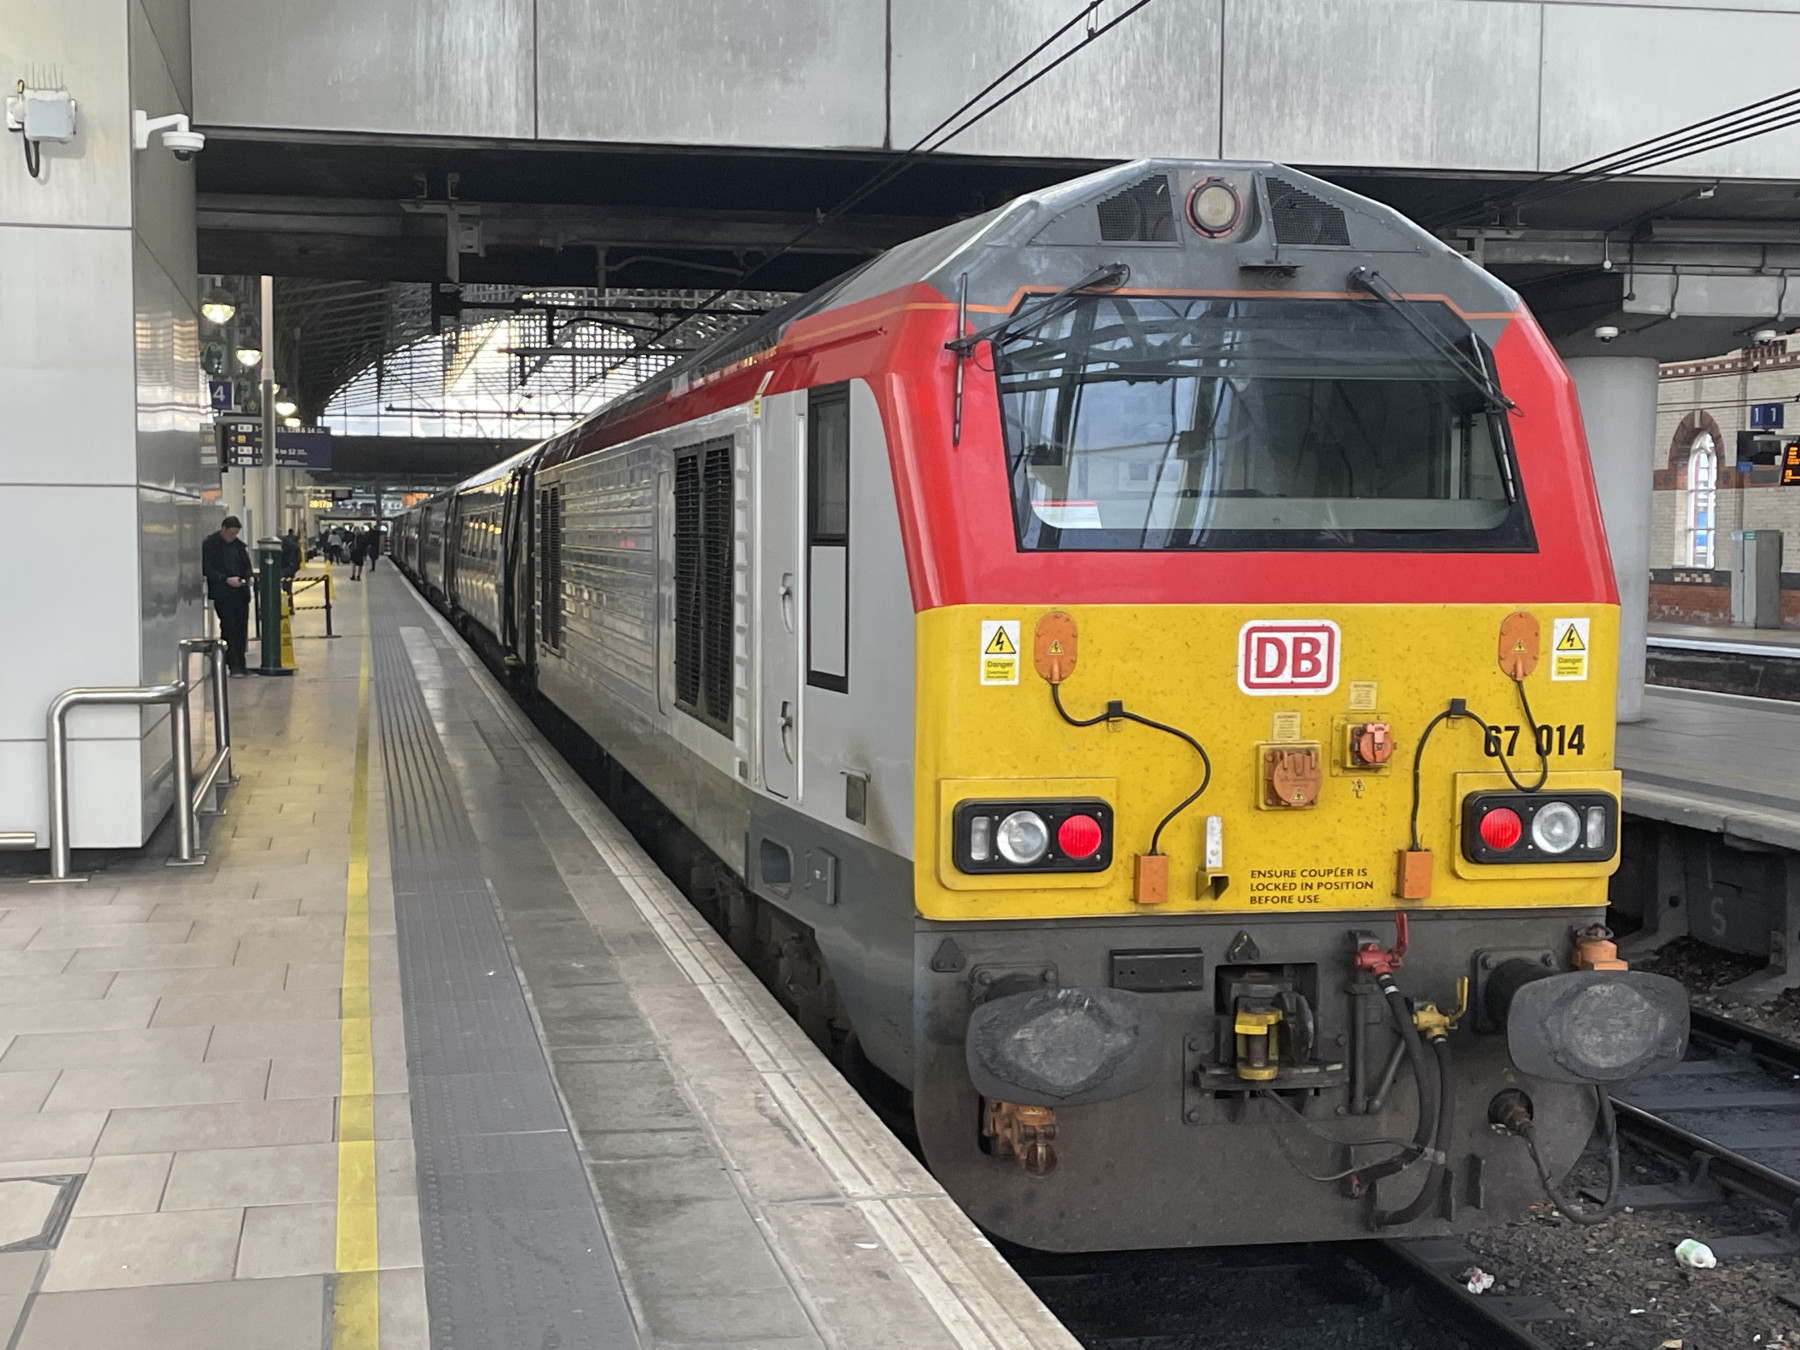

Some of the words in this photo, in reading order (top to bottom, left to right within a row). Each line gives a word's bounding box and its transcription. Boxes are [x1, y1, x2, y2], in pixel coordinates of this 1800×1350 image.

[213, 385, 226, 402] 4
[1256, 636, 1322, 679] DB
[1557, 656, 1583, 665] Danger
[987, 660, 1014, 669] Danger
[1484, 725, 1520, 757] 67
[1535, 724, 1585, 757] 014
[1250, 869, 1297, 879] ENSURE
[1300, 867, 1354, 878] COUPLER
[1357, 868, 1368, 877] IS
[1250, 882, 1297, 892] LOCKED
[1301, 882, 1313, 891] IN
[1317, 880, 1374, 890] POSITION
[1249, 895, 1294, 905] BEFORE
[1297, 894, 1320, 904] USE
